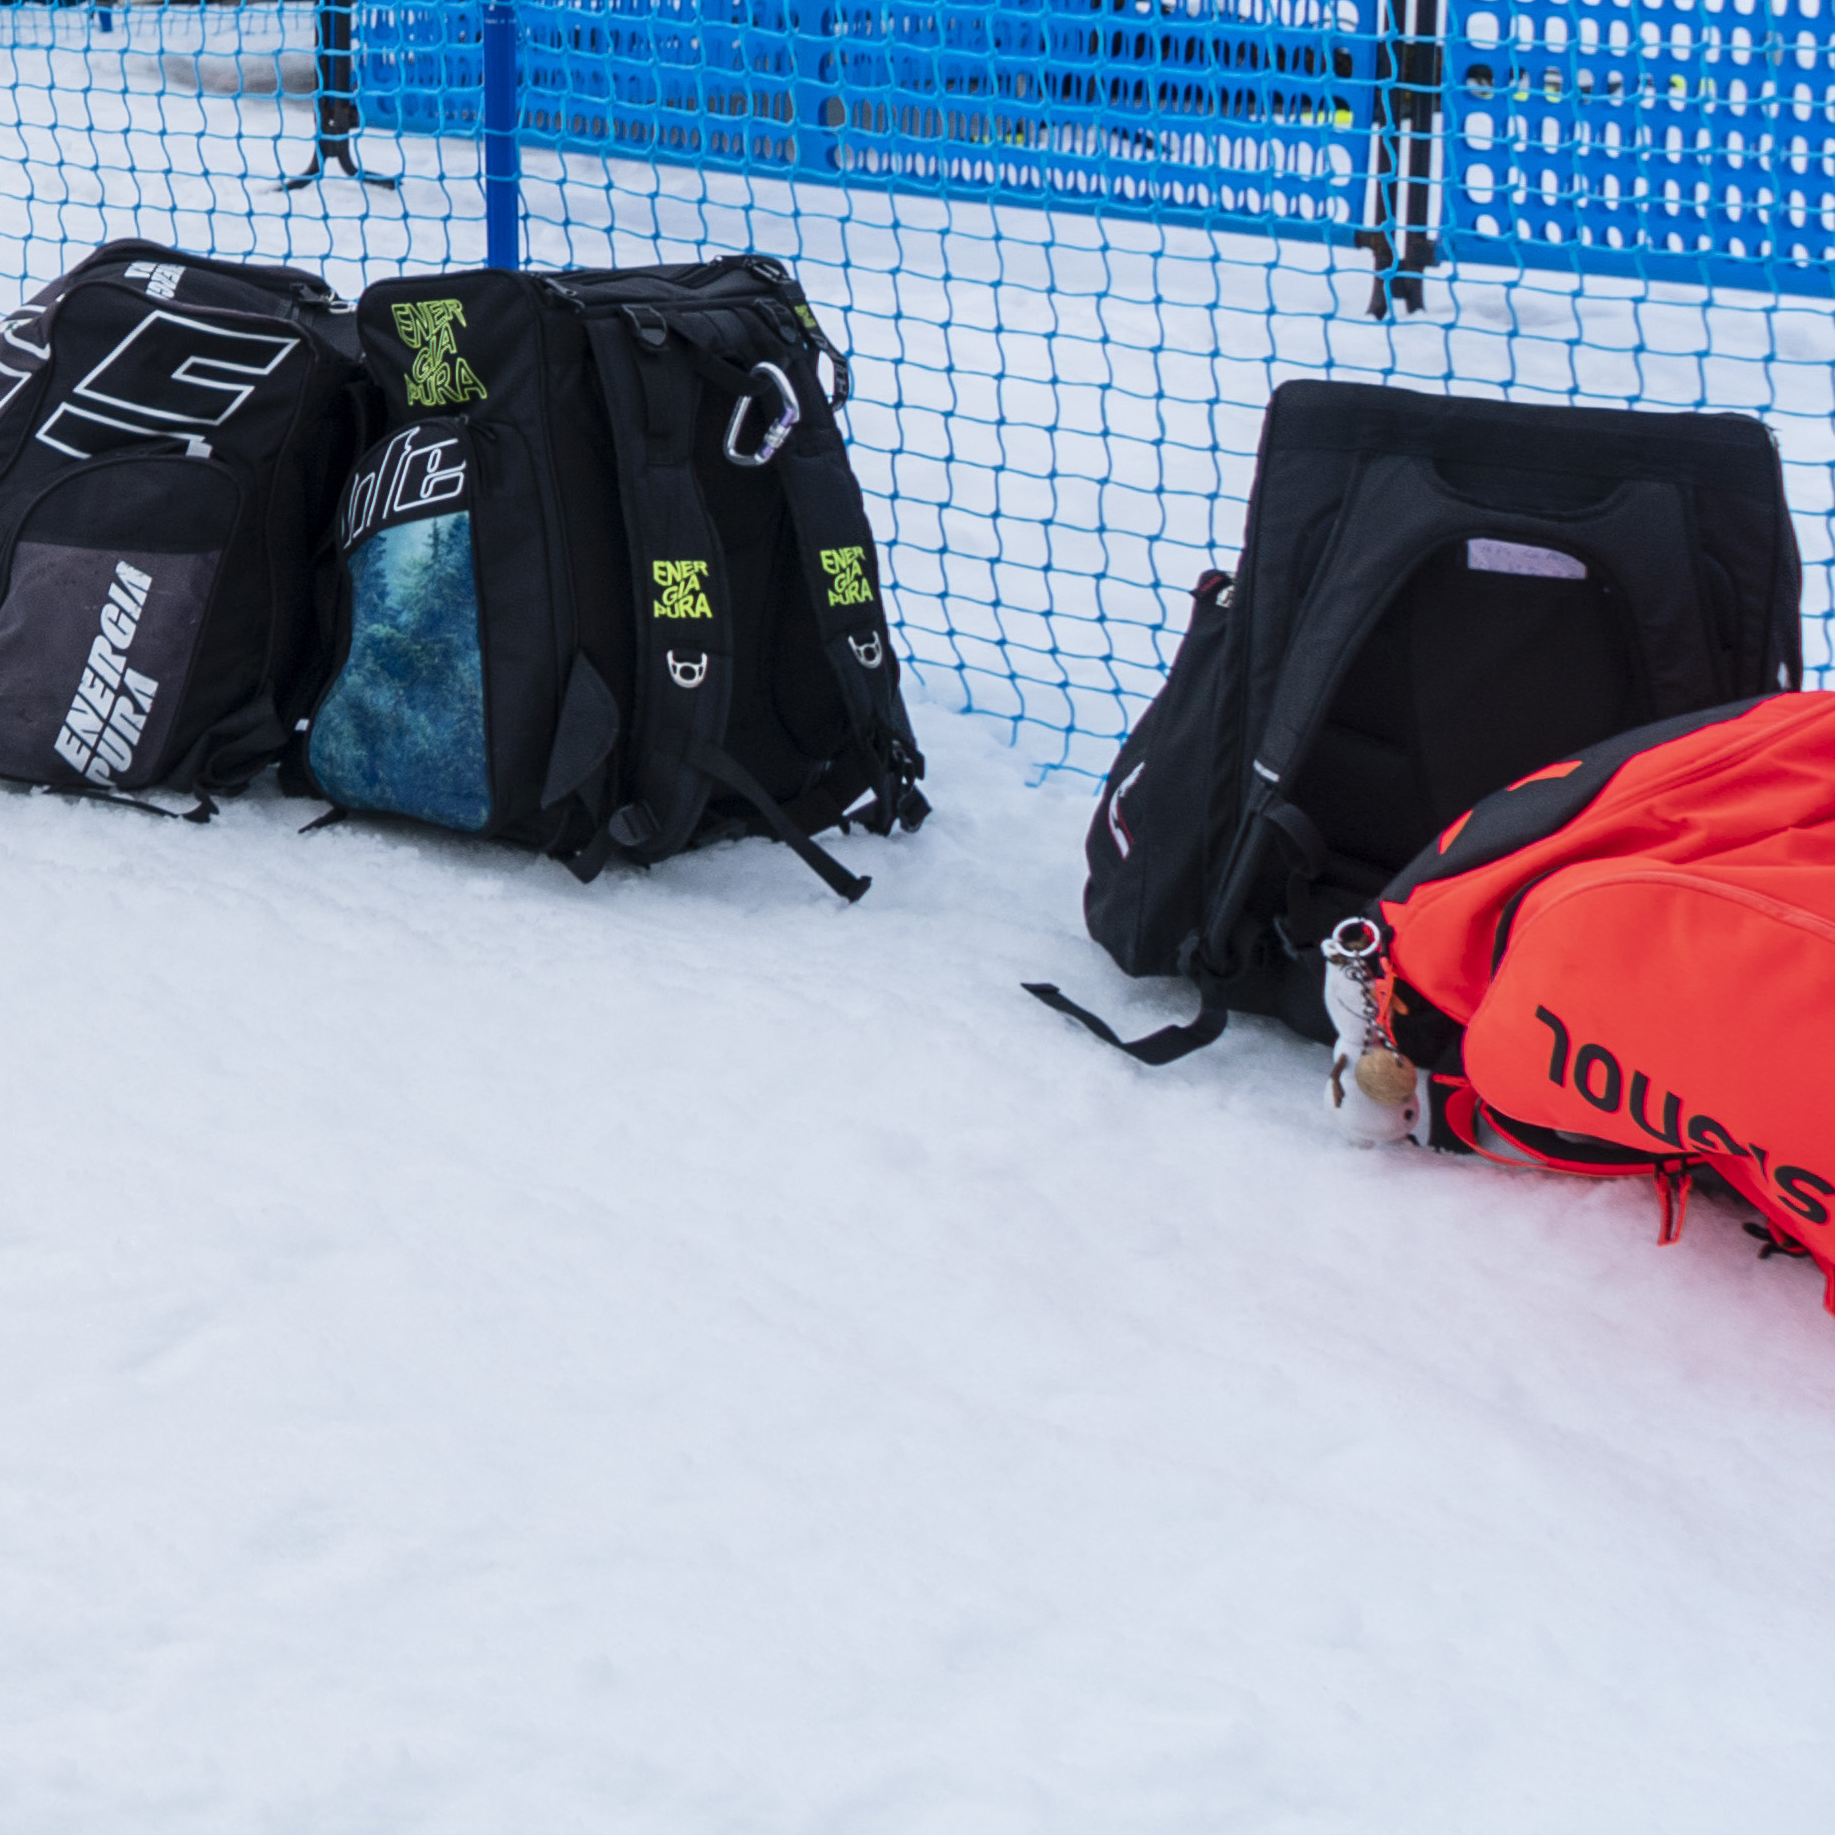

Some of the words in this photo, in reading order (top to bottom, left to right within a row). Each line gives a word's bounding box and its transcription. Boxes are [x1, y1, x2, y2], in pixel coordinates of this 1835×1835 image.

[652, 560, 710, 586] ENER
[53, 559, 153, 776] ENERGIA
[82, 667, 159, 788] PURA
